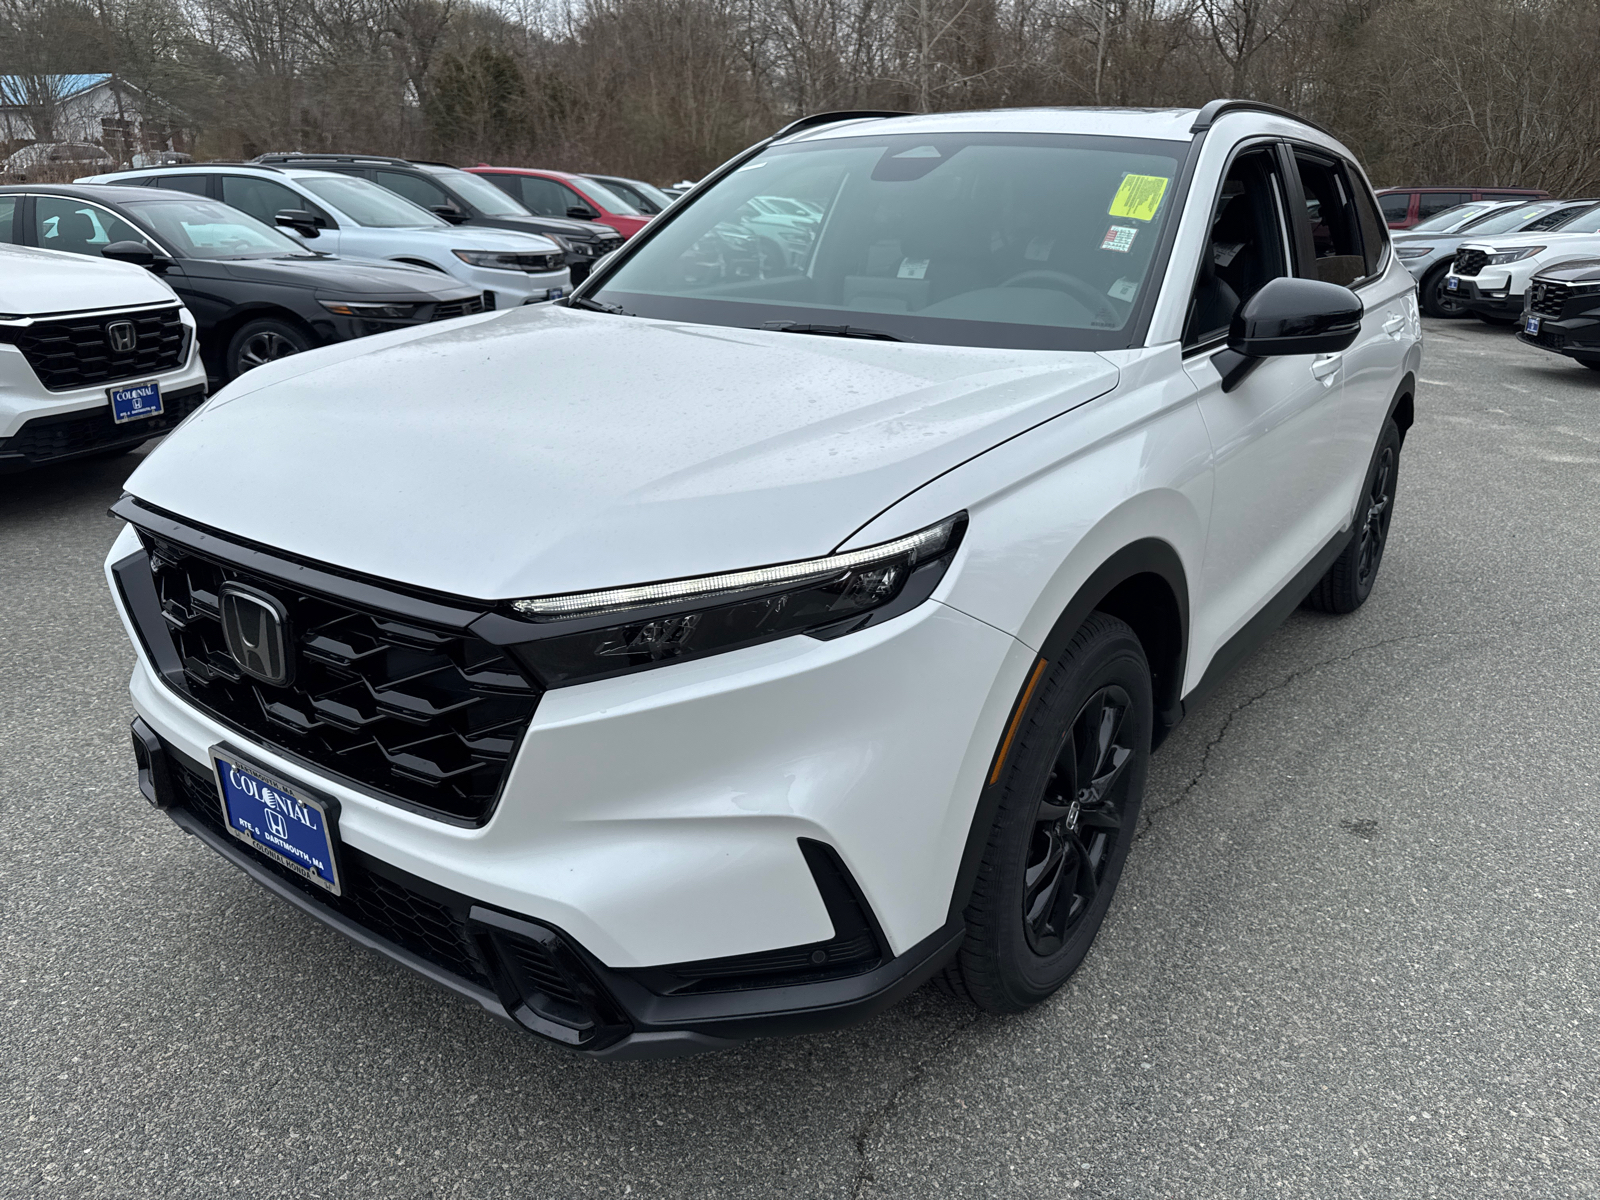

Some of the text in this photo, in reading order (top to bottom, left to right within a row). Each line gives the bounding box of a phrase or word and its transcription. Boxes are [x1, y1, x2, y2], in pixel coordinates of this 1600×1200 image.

[117, 387, 154, 401] COLONIAL
[230, 769, 317, 830] COLONIAL
[282, 785, 295, 796] MA
[239, 818, 324, 870] RTE. 6 DARTMOUTH, MA
[252, 841, 311, 879] COLONIAL HONDA
